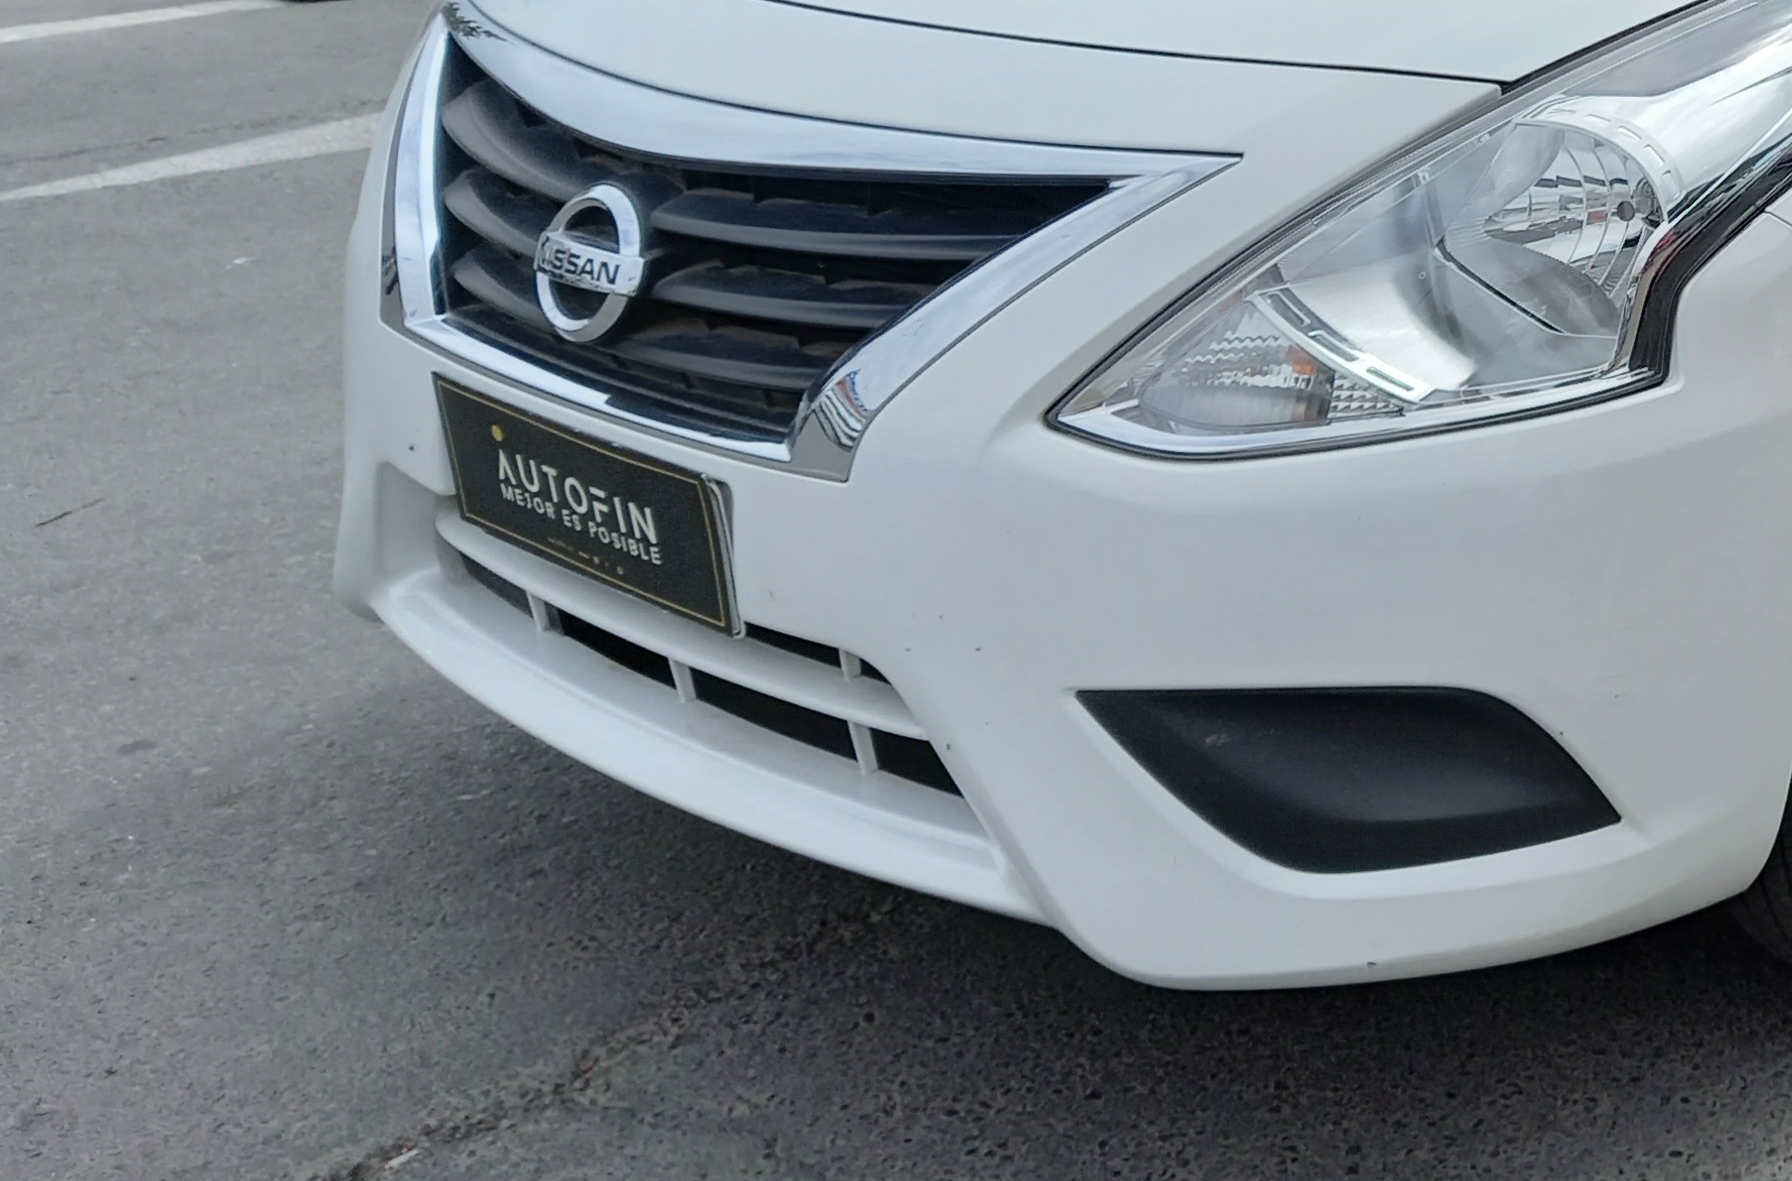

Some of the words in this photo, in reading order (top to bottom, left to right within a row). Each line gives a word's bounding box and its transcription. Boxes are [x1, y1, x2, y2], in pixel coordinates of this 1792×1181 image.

[498, 448, 657, 544] AUTOFIN
[501, 484, 556, 520] MEJOR
[562, 509, 582, 531] ES
[589, 521, 662, 565] POSIBLE
